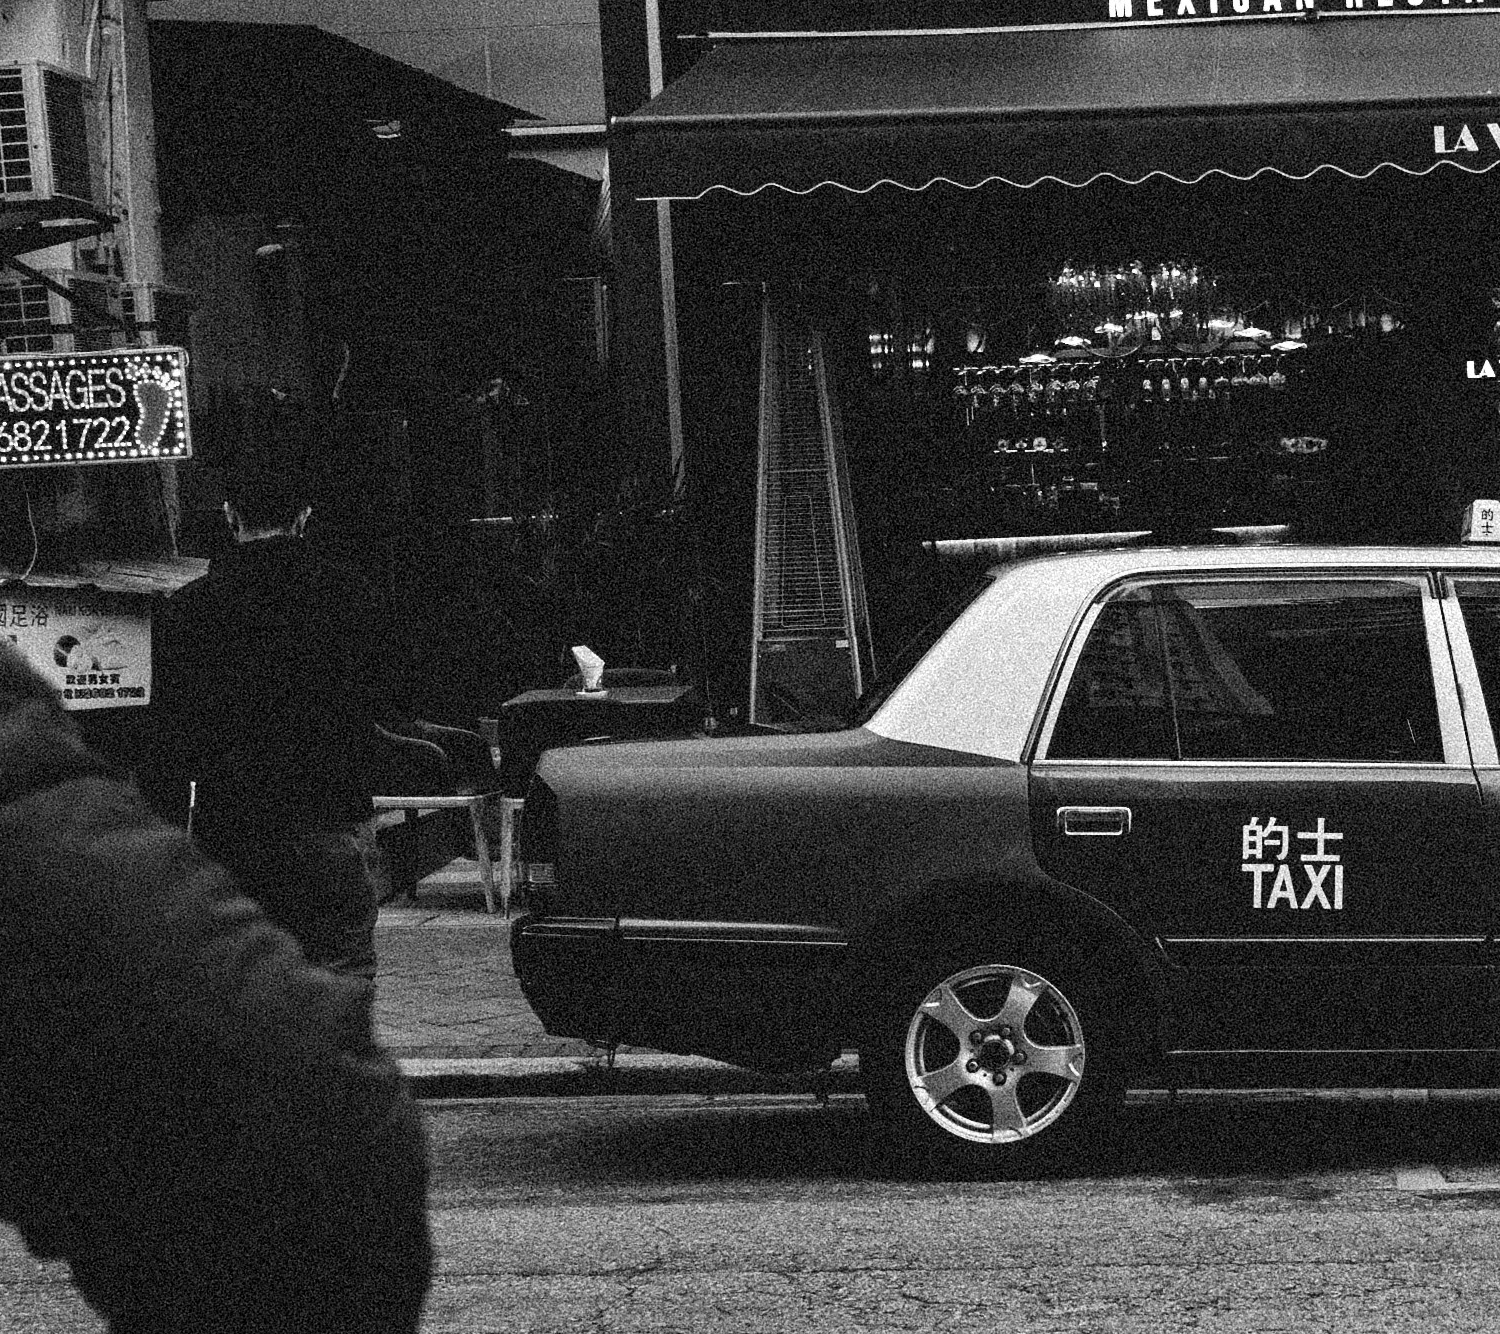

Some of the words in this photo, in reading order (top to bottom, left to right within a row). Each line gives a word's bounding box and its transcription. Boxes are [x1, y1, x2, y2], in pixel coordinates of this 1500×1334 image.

[1433, 124, 1479, 155] LA
[1466, 360, 1495, 379] LA
[1480, 508, 1495, 536] 的士
[1242, 816, 1344, 862] 的士
[1241, 863, 1344, 910] TAXI
